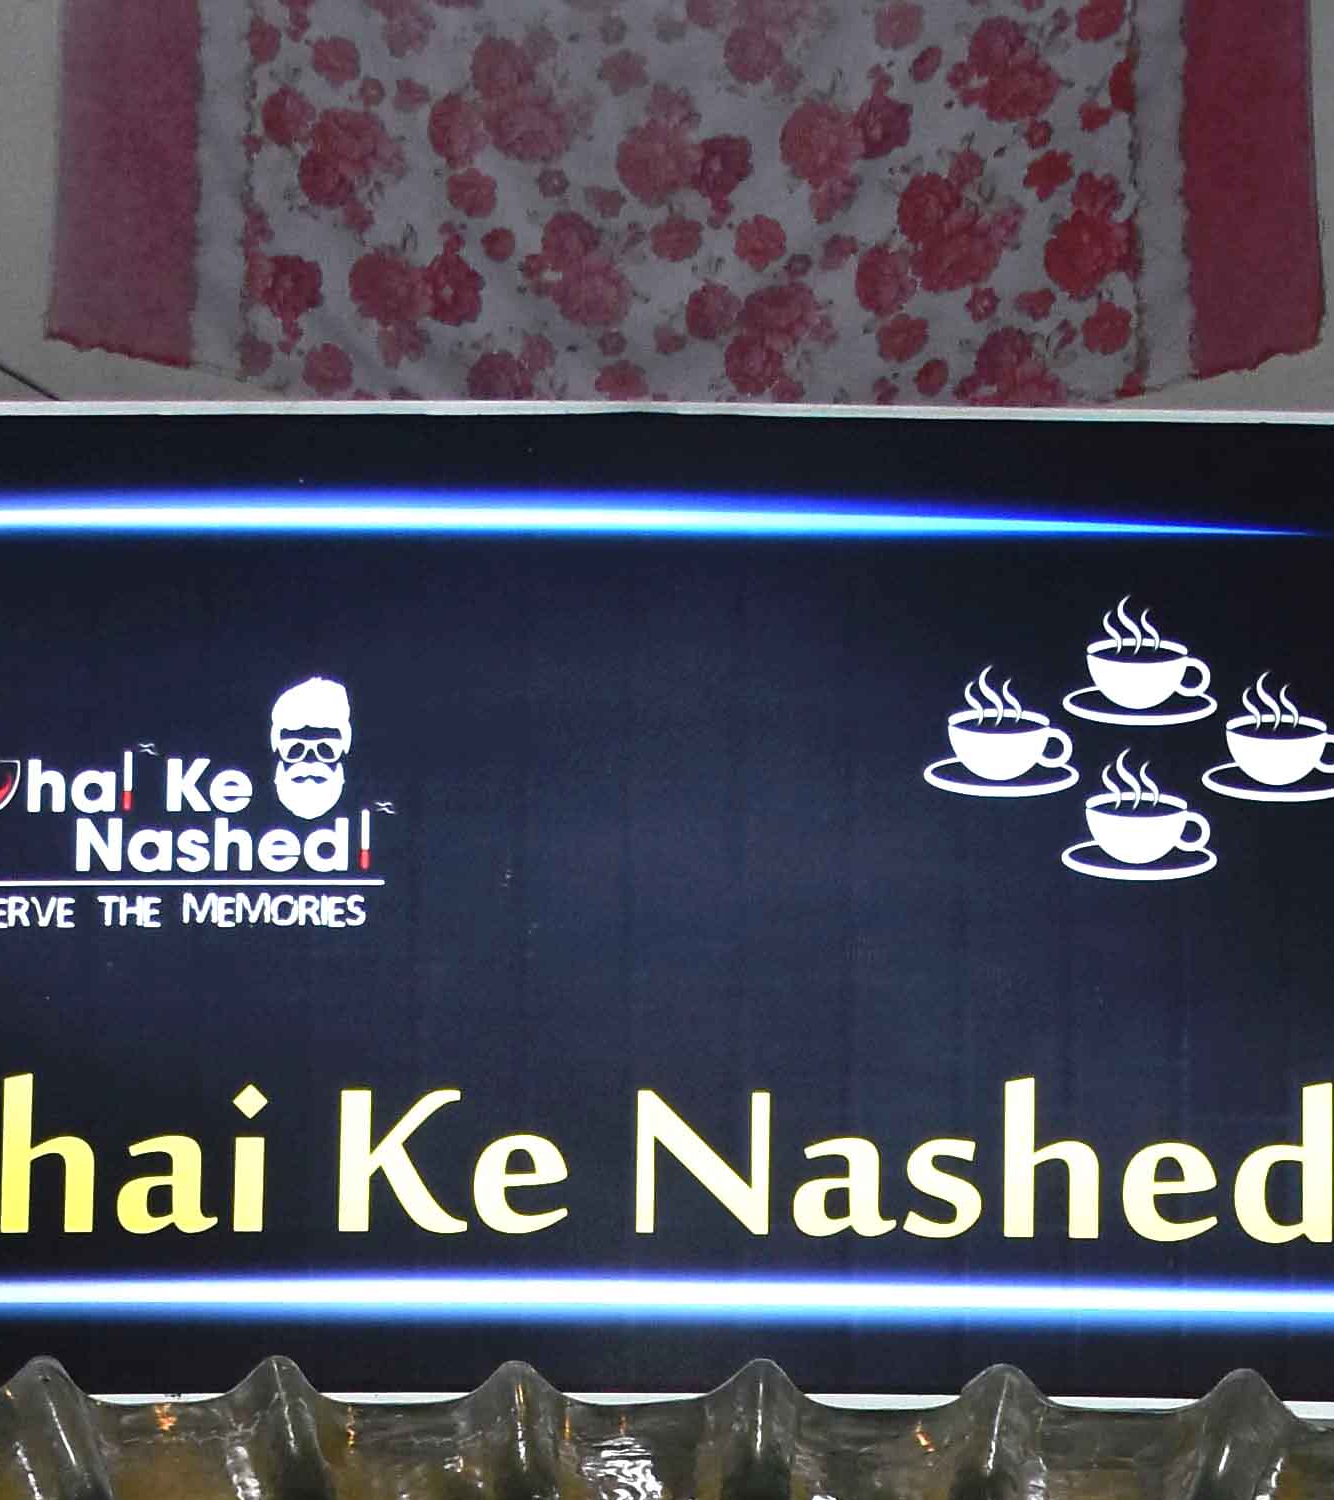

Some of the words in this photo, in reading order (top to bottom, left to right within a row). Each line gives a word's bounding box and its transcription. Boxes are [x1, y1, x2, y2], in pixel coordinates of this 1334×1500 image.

[165, 757, 253, 814] Ke
[96, 894, 162, 928] THE
[182, 891, 367, 928] MEMORIES
[338, 1088, 569, 1235] Ke
